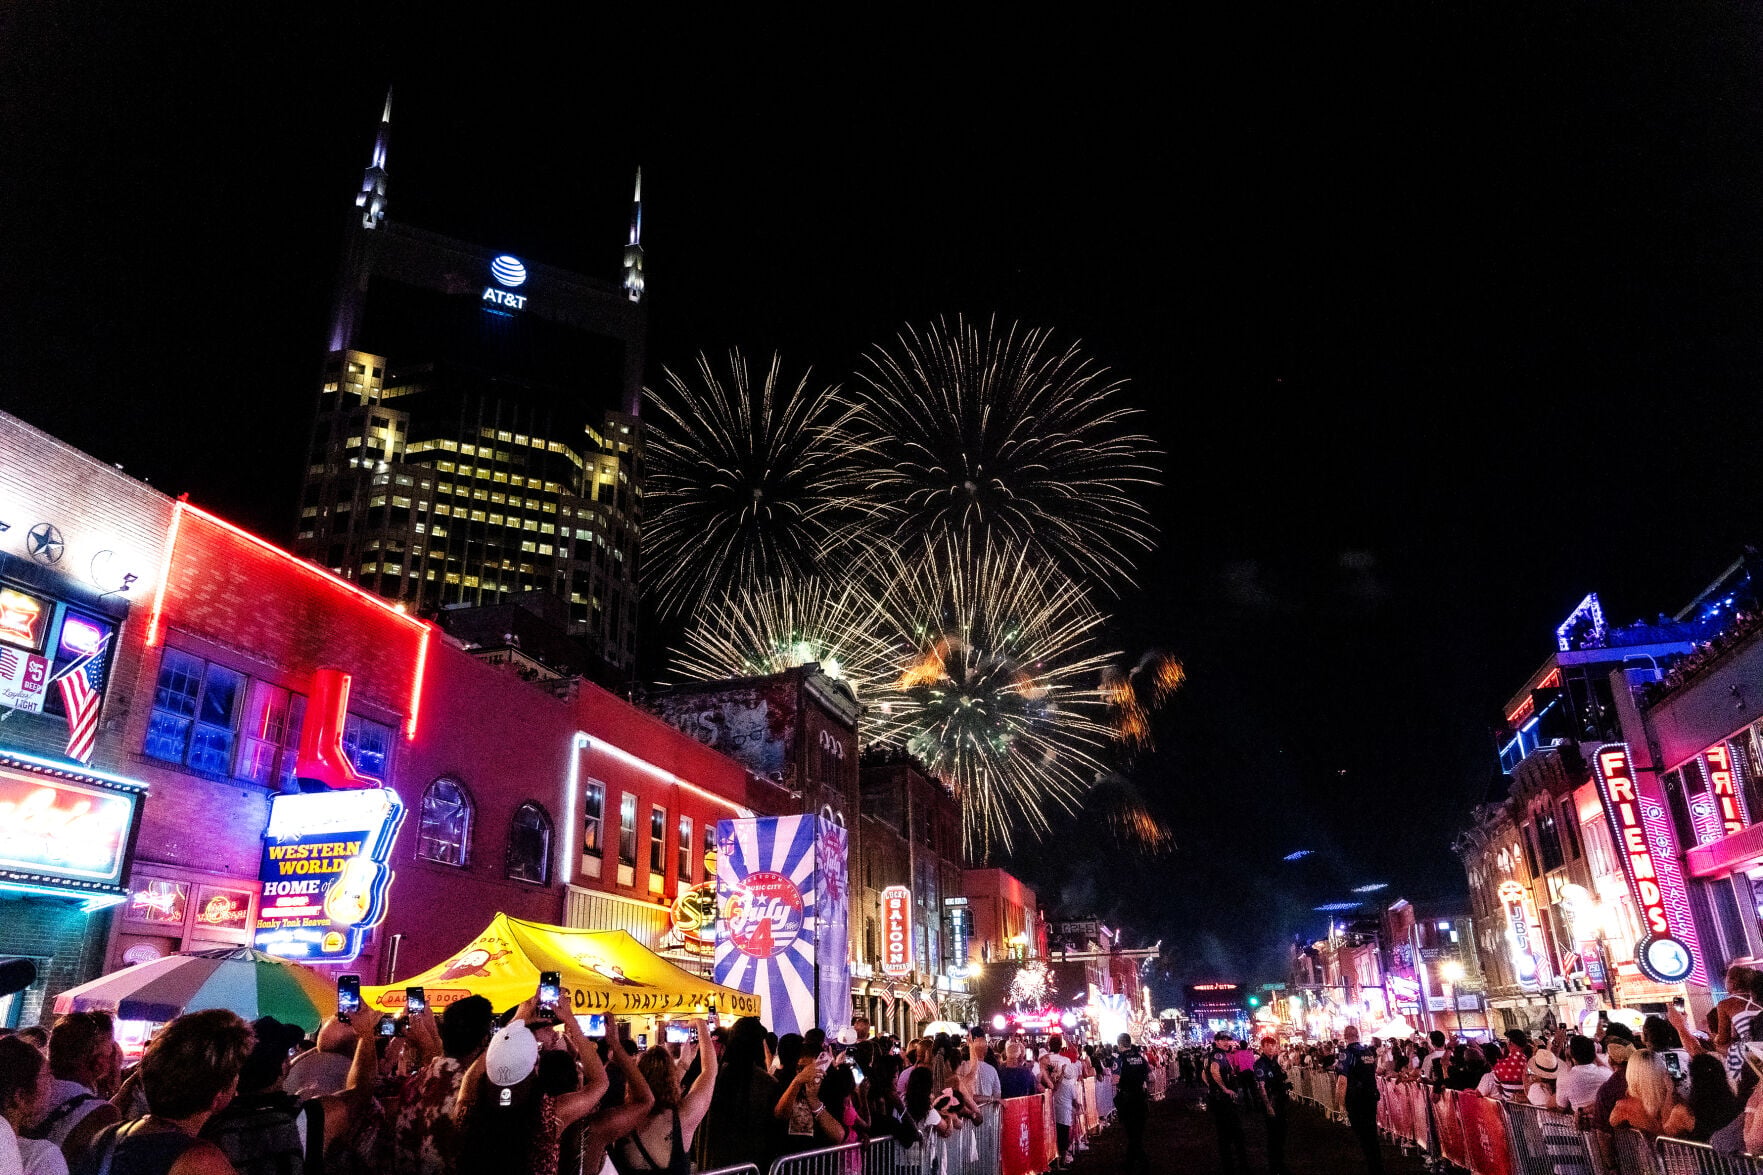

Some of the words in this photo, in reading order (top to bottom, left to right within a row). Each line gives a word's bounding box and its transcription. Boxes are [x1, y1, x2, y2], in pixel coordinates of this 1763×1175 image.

[483, 288, 527, 309] AT&T
[29, 661, 44, 681] $5
[269, 842, 361, 860] WESTERN
[1601, 752, 1667, 932] FRIENDS
[279, 859, 346, 875] WORLD
[264, 880, 320, 895] HOME
[321, 878, 333, 895] of
[1654, 826, 1670, 859] LOW
[1664, 864, 1687, 935] PLACES
[885, 890, 908, 899] LUCKY
[256, 919, 281, 930] Honky
[283, 917, 301, 927] Tonk
[302, 917, 331, 926] Heaven
[729, 892, 792, 935] July
[747, 917, 776, 958] 4
[889, 899, 904, 964] SALOON
[952, 909, 962, 967] WHISKEY
[1513, 907, 1527, 949] JBJ
[622, 992, 670, 1009] THAT'S
[672, 994, 684, 1008] A
[731, 994, 757, 1013] DOG!
